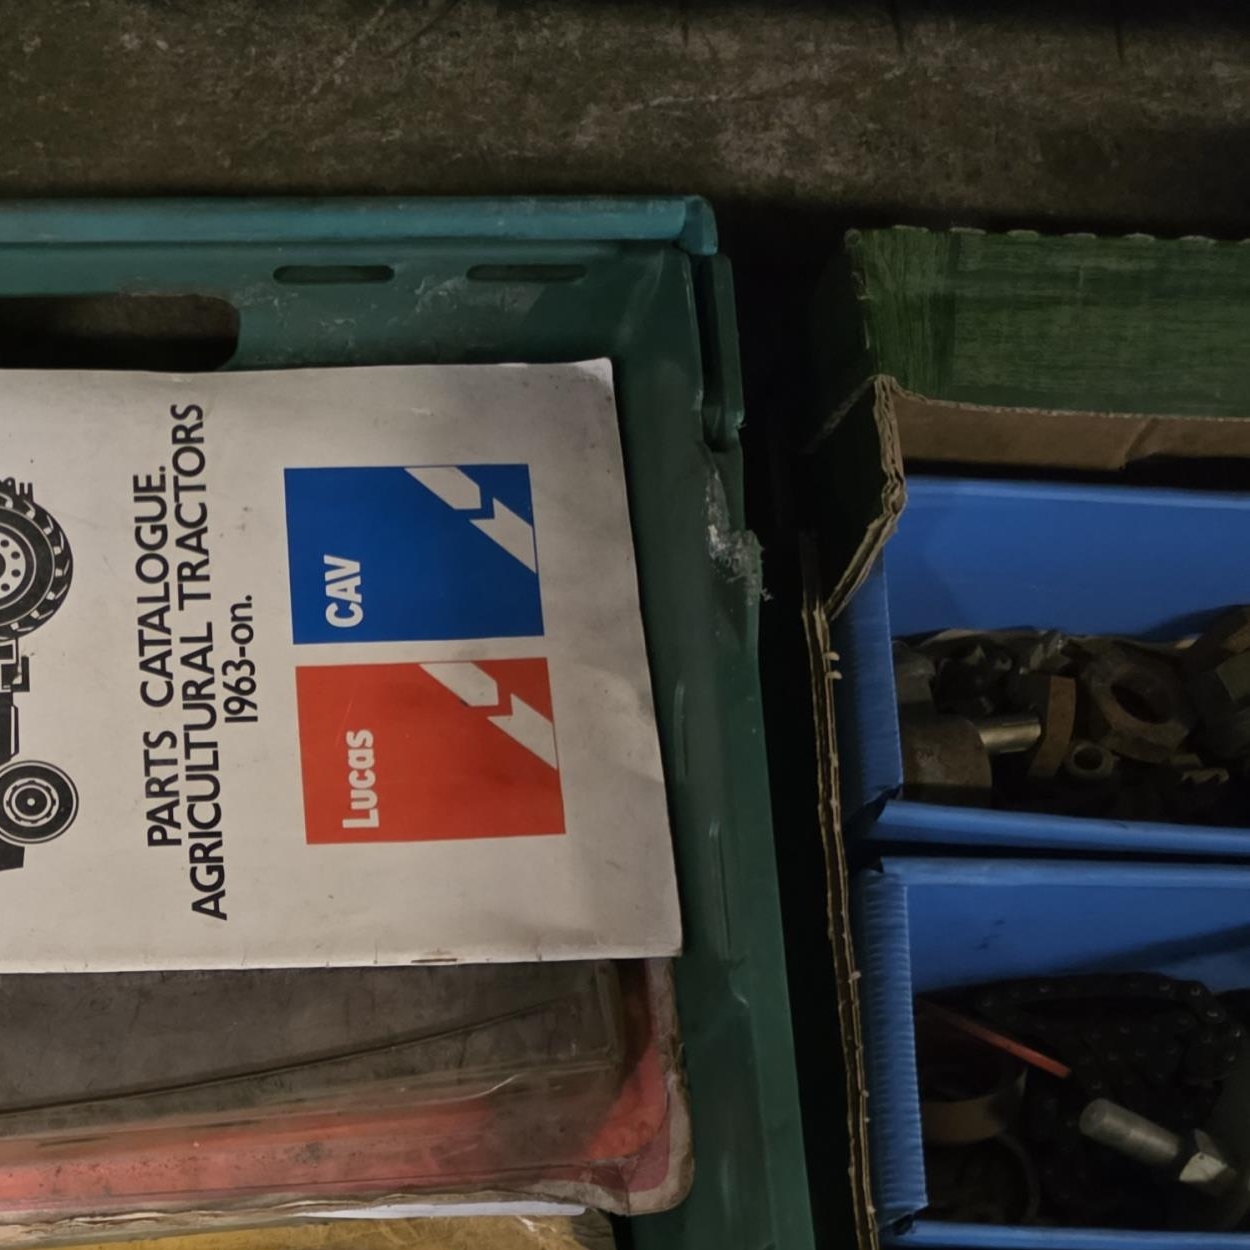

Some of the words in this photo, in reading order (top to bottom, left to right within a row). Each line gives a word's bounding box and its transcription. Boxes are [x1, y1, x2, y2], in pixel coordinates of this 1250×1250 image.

[170, 403, 212, 612] TRACTORS
[133, 466, 175, 709] CATALOGUE.
[323, 554, 364, 628] CAV
[223, 594, 259, 724] 1963-on.
[146, 729, 182, 847] PARTS
[179, 621, 228, 921] AGRICULTURAL
[342, 728, 380, 828] Lucas
